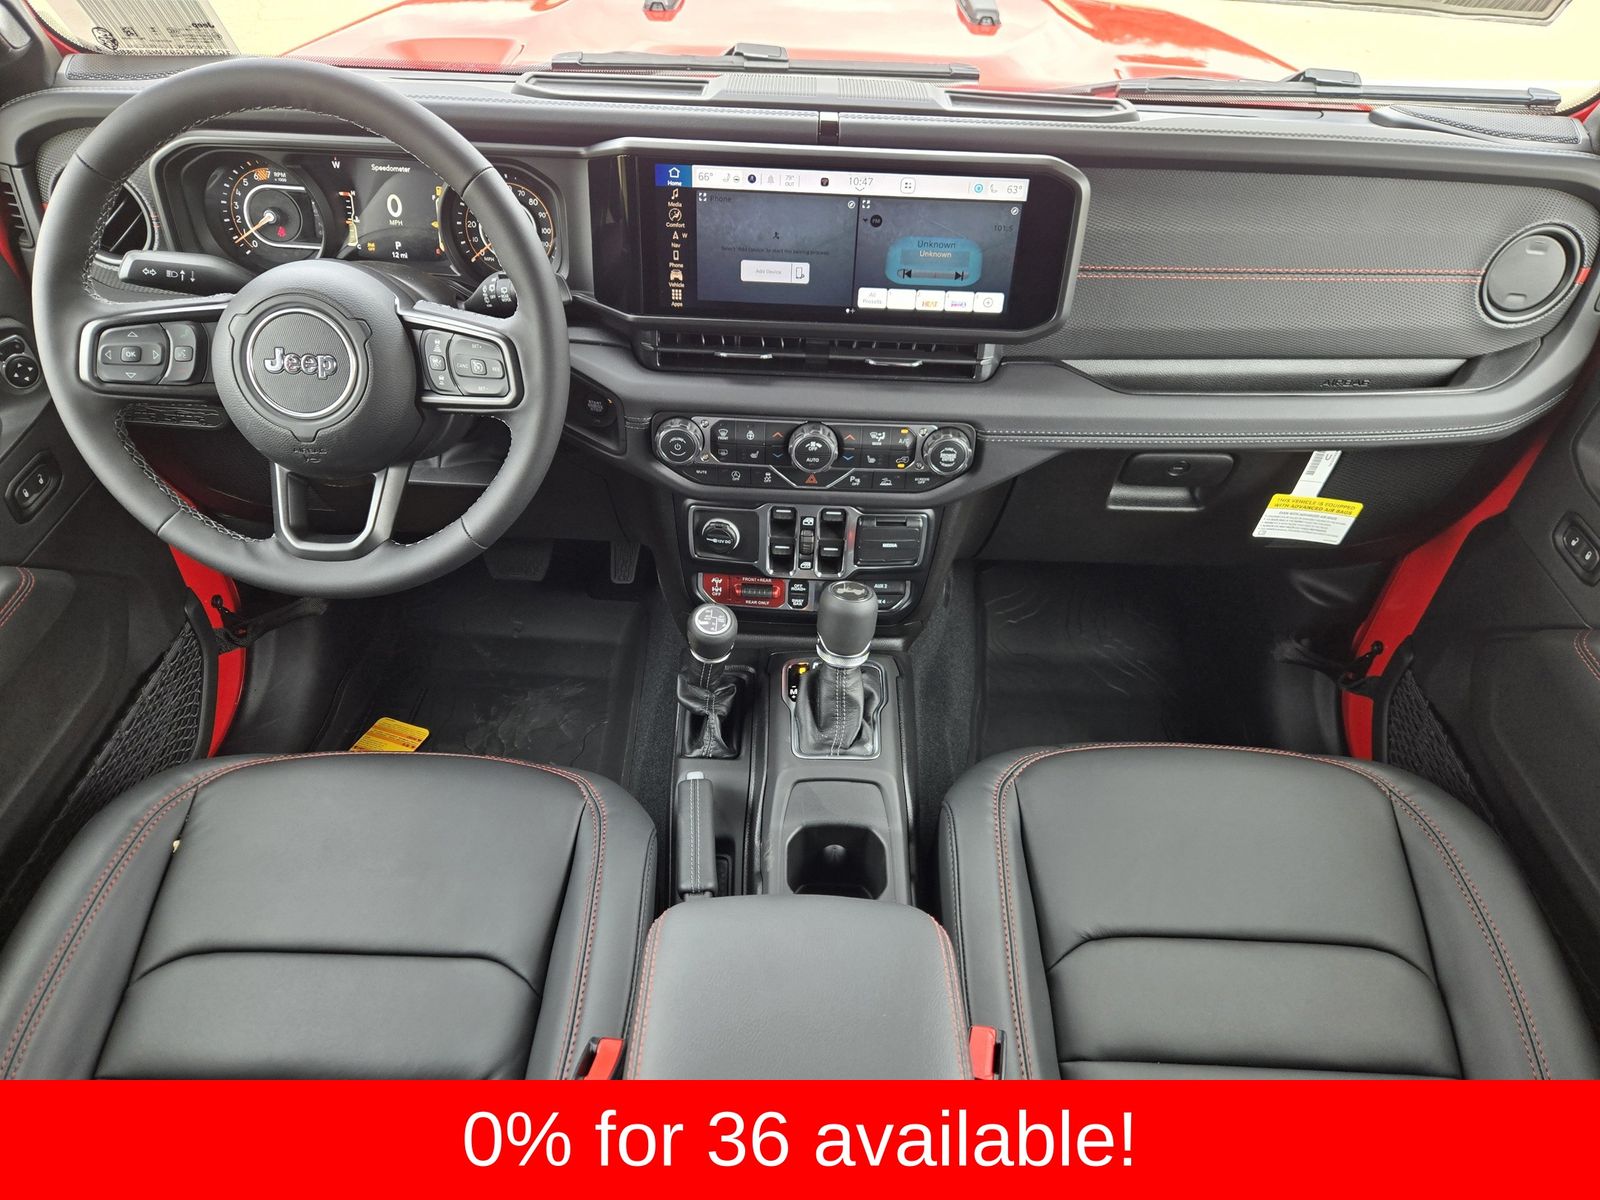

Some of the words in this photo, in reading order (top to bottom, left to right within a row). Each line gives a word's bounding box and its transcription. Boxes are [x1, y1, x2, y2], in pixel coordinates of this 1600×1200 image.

[370, 163, 411, 173] Speedometer
[242, 179, 249, 187] 5
[849, 176, 874, 187] 10:47
[233, 201, 239, 209] 3
[386, 193, 403, 218] 0
[528, 198, 539, 206] 80
[236, 215, 242, 223] 2
[538, 211, 547, 219] 90
[467, 220, 477, 228] 20
[252, 240, 258, 248] 0
[394, 241, 402, 250] P
[917, 240, 956, 249] Unknown
[919, 250, 952, 258] Unknown
[263, 347, 338, 381] Jeep
[1325, 502, 1356, 510] EQUIPPED
